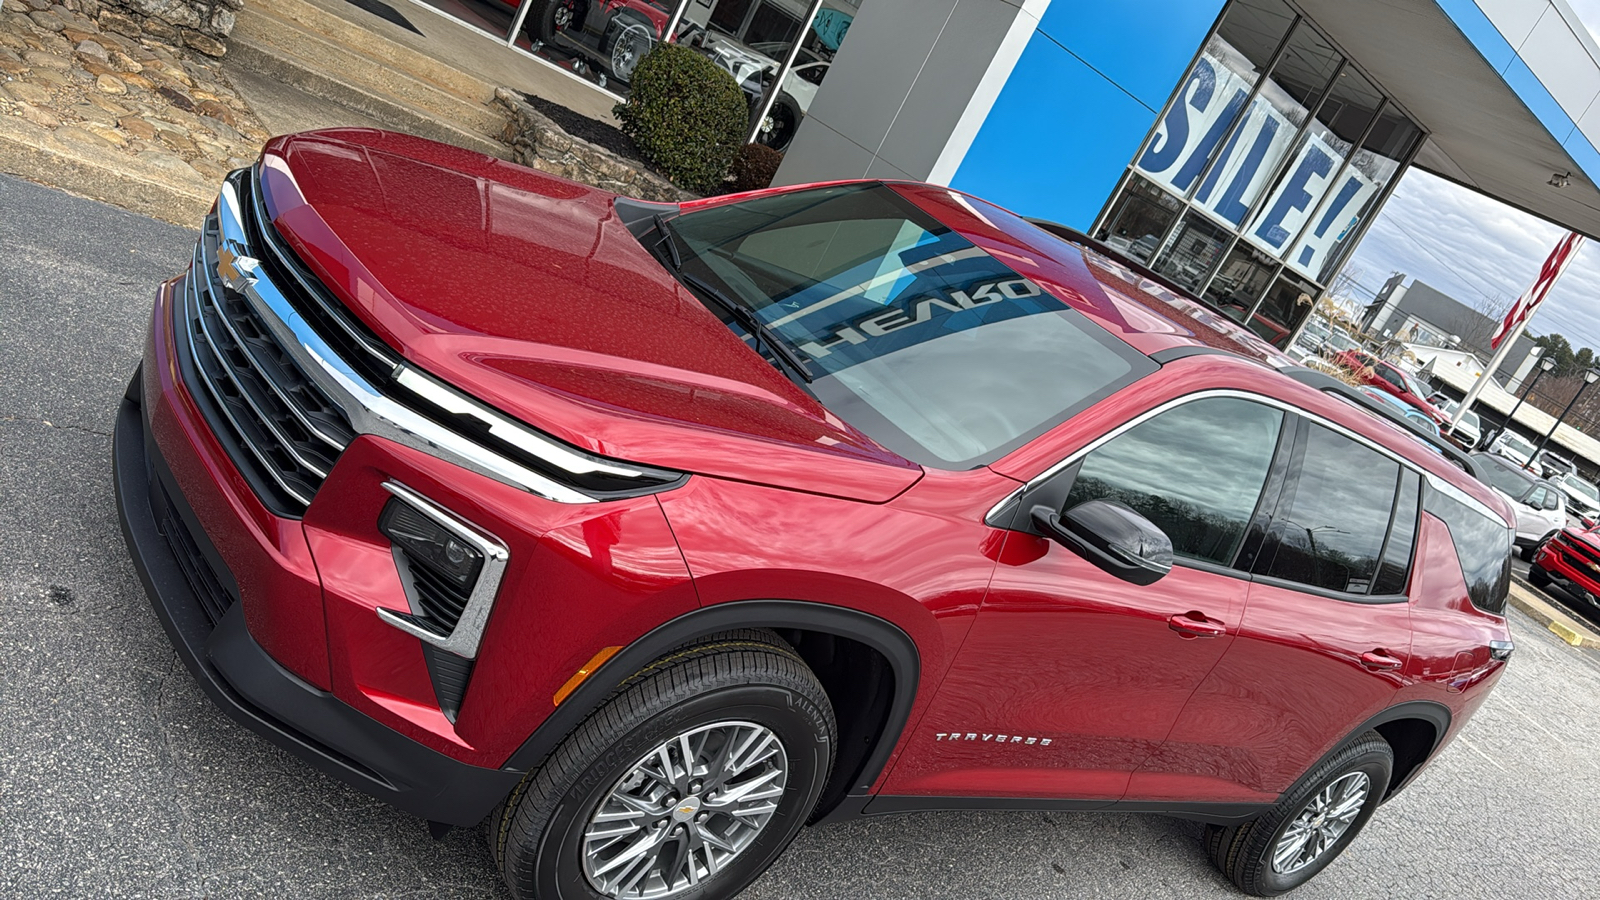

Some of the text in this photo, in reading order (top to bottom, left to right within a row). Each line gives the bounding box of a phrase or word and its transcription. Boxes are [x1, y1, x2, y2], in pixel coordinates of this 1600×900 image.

[1138, 57, 1363, 268] SALE!
[795, 697, 827, 735] ALENZA
[935, 732, 1053, 746] TRAVERSE
